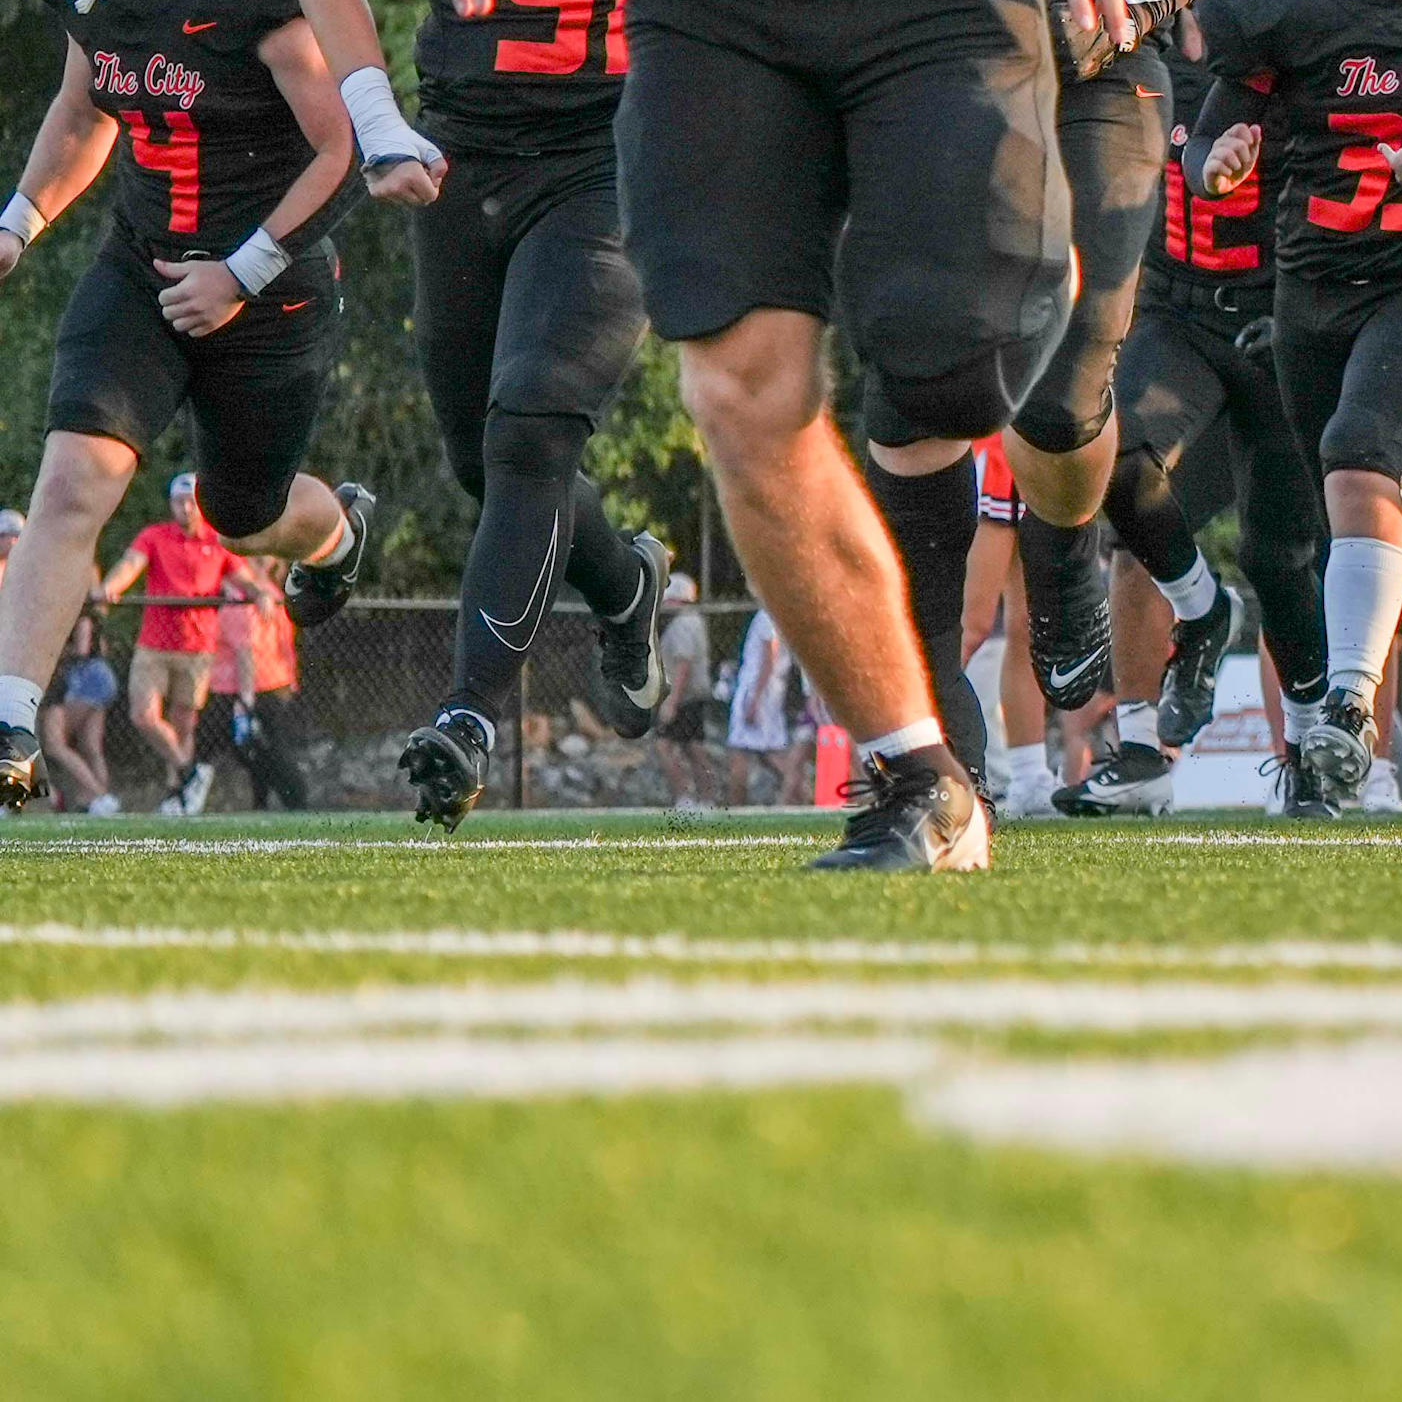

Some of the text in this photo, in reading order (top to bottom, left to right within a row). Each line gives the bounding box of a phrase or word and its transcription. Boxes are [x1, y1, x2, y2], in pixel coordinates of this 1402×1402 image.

[93, 50, 205, 110] The City
[1337, 56, 1399, 97] The
[119, 111, 200, 232] 4
